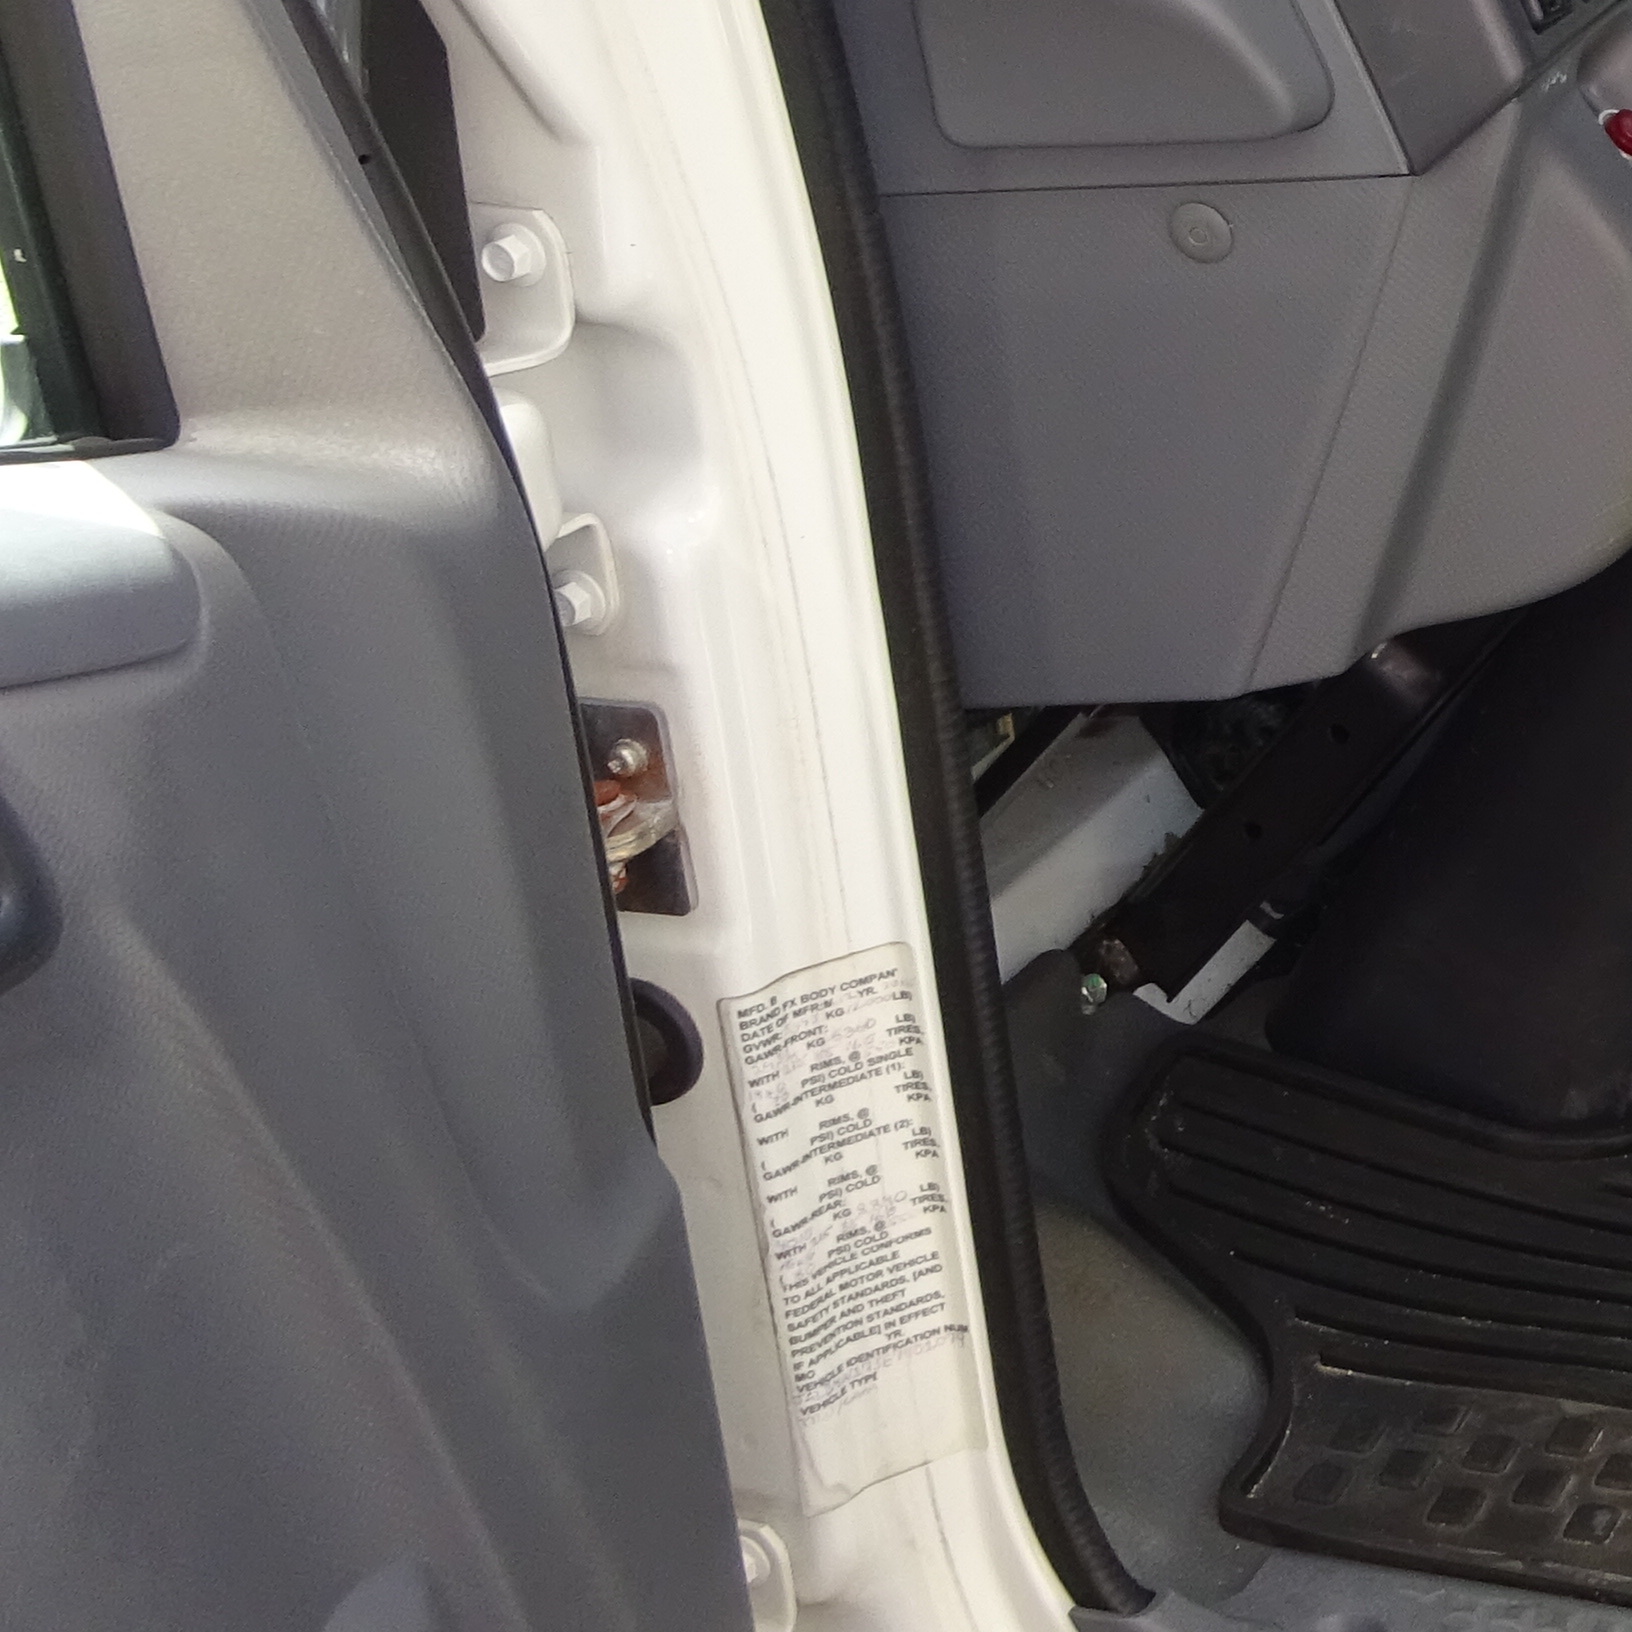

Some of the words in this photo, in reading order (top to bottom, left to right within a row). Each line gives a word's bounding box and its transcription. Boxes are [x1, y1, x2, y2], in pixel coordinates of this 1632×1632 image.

[739, 1007, 781, 1030] BRAND
[782, 998, 797, 1011] FX
[800, 985, 836, 1004] BODY
[825, 1007, 845, 1020] KG
[741, 1022, 774, 1043] DATE
[776, 1014, 790, 1027] OF
[806, 1037, 826, 1050] KG
[828, 1061, 864, 1079] COLD
[866, 1047, 914, 1067] SINGLE
[748, 1071, 780, 1089] WITH
[815, 1094, 835, 1107] KG
[906, 1093, 932, 1103] KPA
[837, 1119, 873, 1136] COLD
[756, 1128, 789, 1147] WITH
[824, 1152, 844, 1165] KG
[915, 1149, 940, 1159] KPA
[845, 1175, 881, 1193] COLD
[766, 1186, 798, 1204] WITH
[832, 1208, 852, 1221] KG
[922, 1204, 948, 1214] KPA
[854, 1230, 889, 1248] COLD
[774, 1243, 807, 1261] WITH
[812, 1253, 858, 1280] VEHICLE
[861, 1227, 932, 1256] CONFORMS
[783, 1294, 801, 1306] TO
[803, 1285, 823, 1299] ALL
[825, 1250, 900, 1285] APPLICABLE
[785, 1289, 836, 1319] FEDERAL
[838, 1270, 884, 1291] MOTOR
[886, 1250, 940, 1274] VEHICLE
[787, 1306, 831, 1332] SAFETY
[788, 1318, 837, 1345] BUMPER
[840, 1304, 865, 1318] AND
[868, 1288, 907, 1308] THEFT
[791, 1317, 863, 1358] PREVENTION
[793, 1361, 805, 1371] IF
[885, 1319, 897, 1330] IN
[900, 1302, 946, 1325] EFFECT
[797, 1362, 845, 1393] VEHICLE
[846, 1326, 941, 1368] IDENTIFICATION
[800, 1386, 848, 1416] VEHICLE
